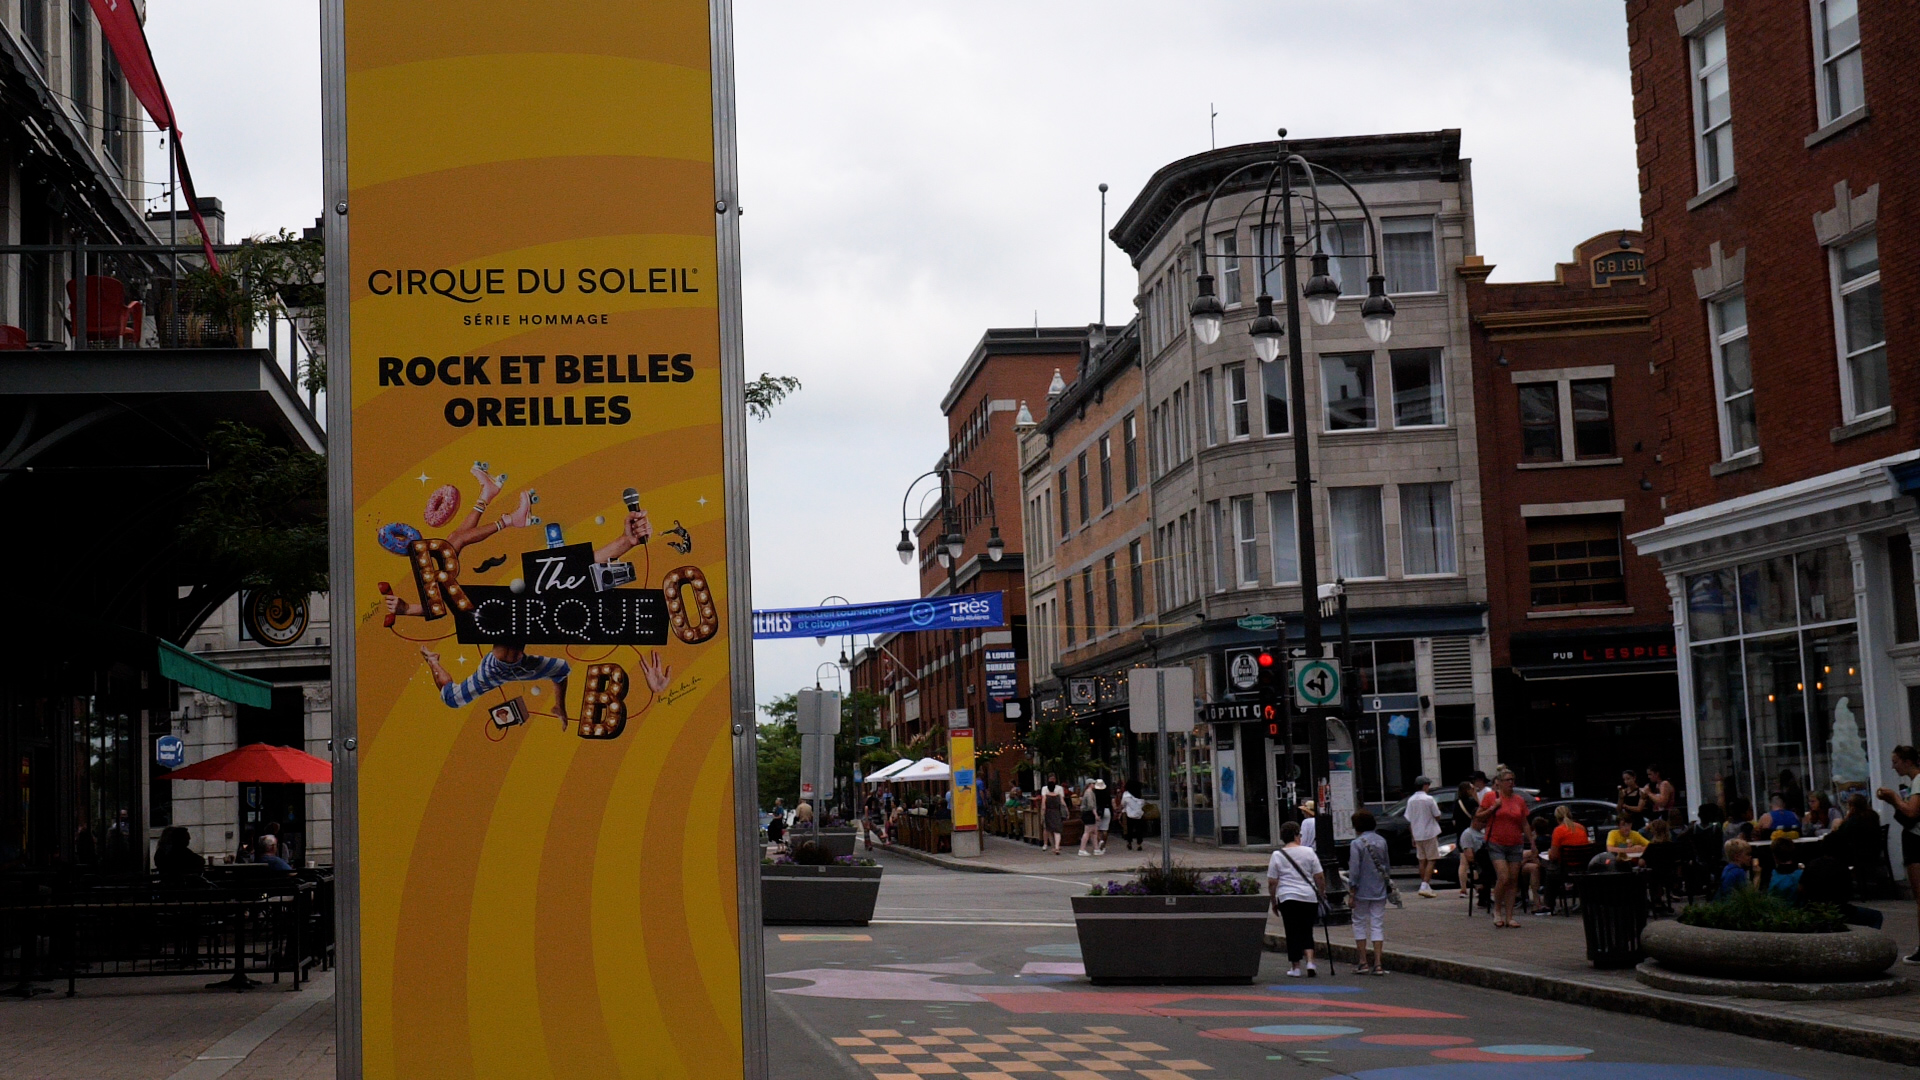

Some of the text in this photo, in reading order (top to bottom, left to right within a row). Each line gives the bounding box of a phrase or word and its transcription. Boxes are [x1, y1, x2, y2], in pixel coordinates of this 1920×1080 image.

[1621, 258, 1646, 272] 191
[368, 268, 505, 303] CIRQUE
[518, 268, 565, 294] DU
[463, 312, 610, 326] SÉRIE HOMMAGE
[378, 353, 695, 387] ROCK ET BELLES
[444, 395, 632, 428] OREILLES
[535, 556, 587, 595] The
[474, 598, 654, 641] CIRQUE
[798, 619, 850, 630] et citoyen
[991, 651, 1015, 660] LOUER
[1552, 651, 1574, 660] PUB
[985, 662, 1015, 672] BUREAUX
[1218, 704, 1249, 720] P'TIT
